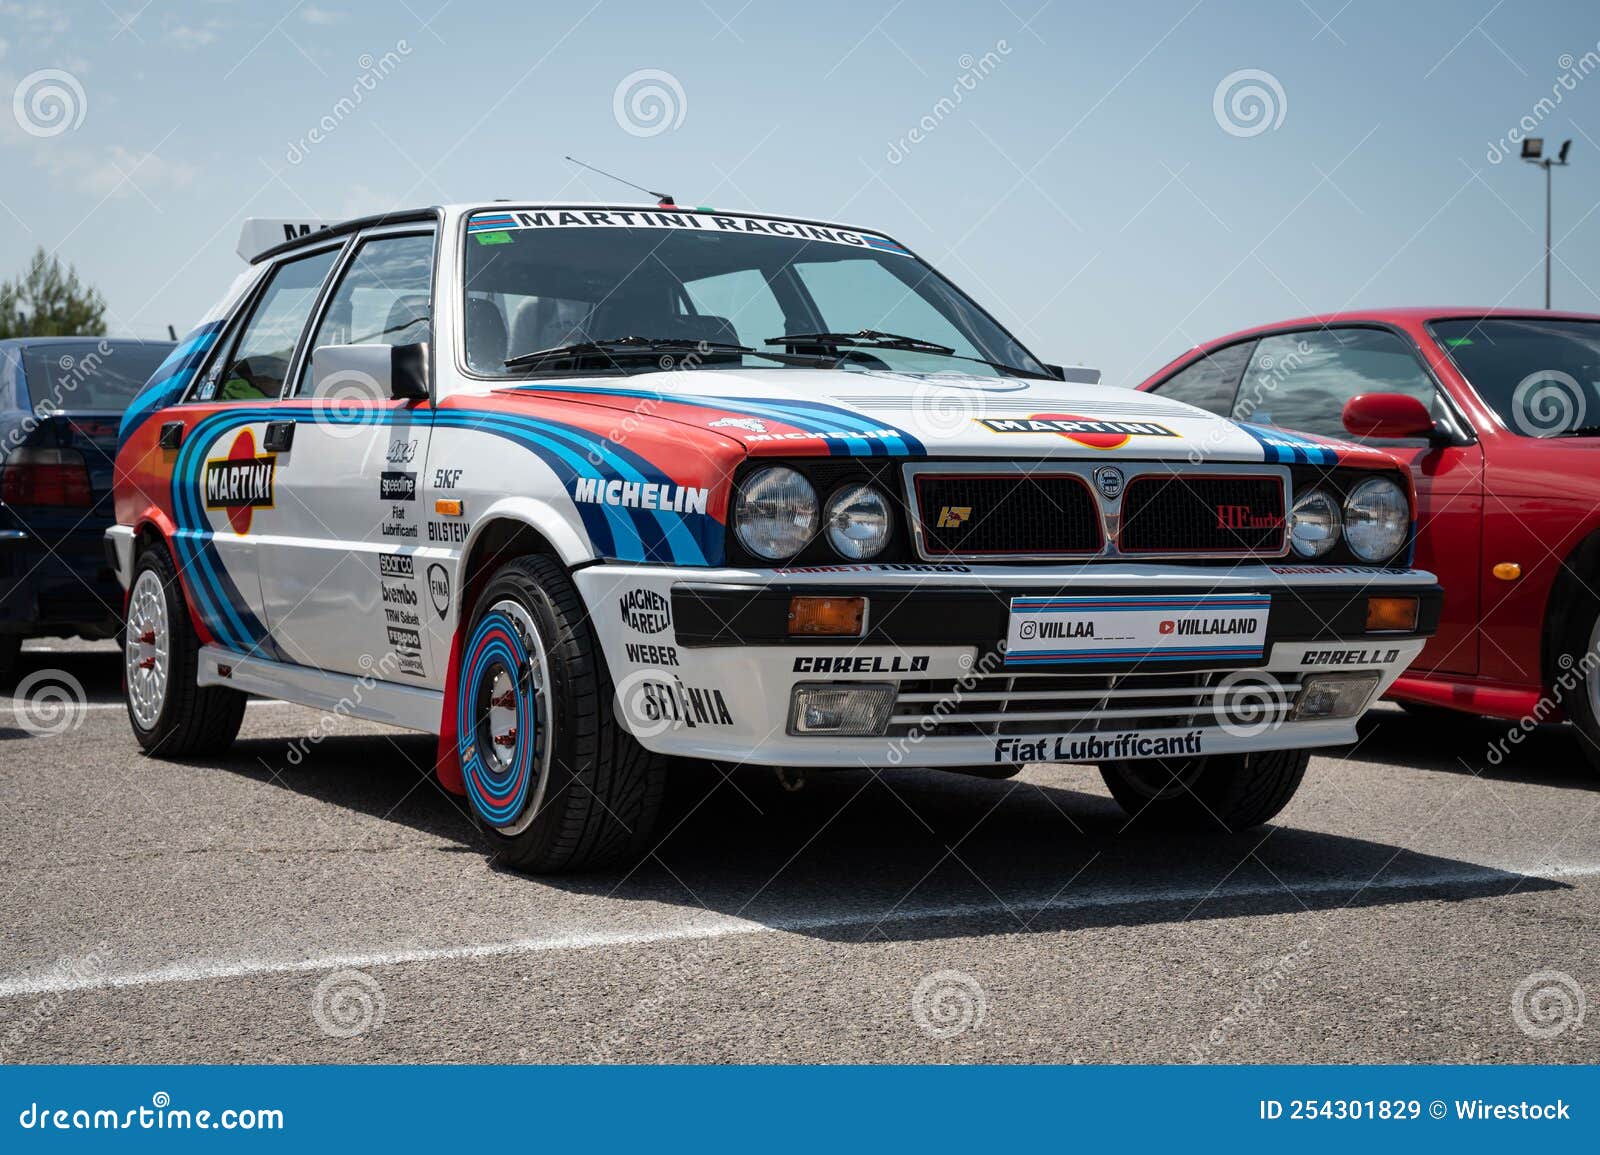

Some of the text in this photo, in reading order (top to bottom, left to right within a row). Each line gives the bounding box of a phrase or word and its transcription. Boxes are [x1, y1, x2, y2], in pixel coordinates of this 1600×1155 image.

[516, 211, 865, 246] MARTINI RACING
[744, 429, 902, 442] MICHELIN
[987, 420, 1168, 435] MARTINI
[208, 464, 272, 501] MARTINI
[433, 469, 463, 489] SKF
[575, 477, 709, 515] MICHELIN
[392, 506, 405, 519] Fiat
[1216, 504, 1250, 529] HF
[382, 523, 418, 538] Lubrificanti
[381, 581, 418, 606] brembo
[431, 580, 448, 598] FINA
[620, 588, 670, 618] MAGNETI
[385, 608, 400, 622] TRW
[1177, 618, 1258, 636] VIILLALAND
[625, 643, 680, 666] WEBER
[792, 655, 930, 673] CARELLO
[1301, 648, 1400, 665] CARELLO
[994, 730, 1203, 762] Fiat Lubrificanti
